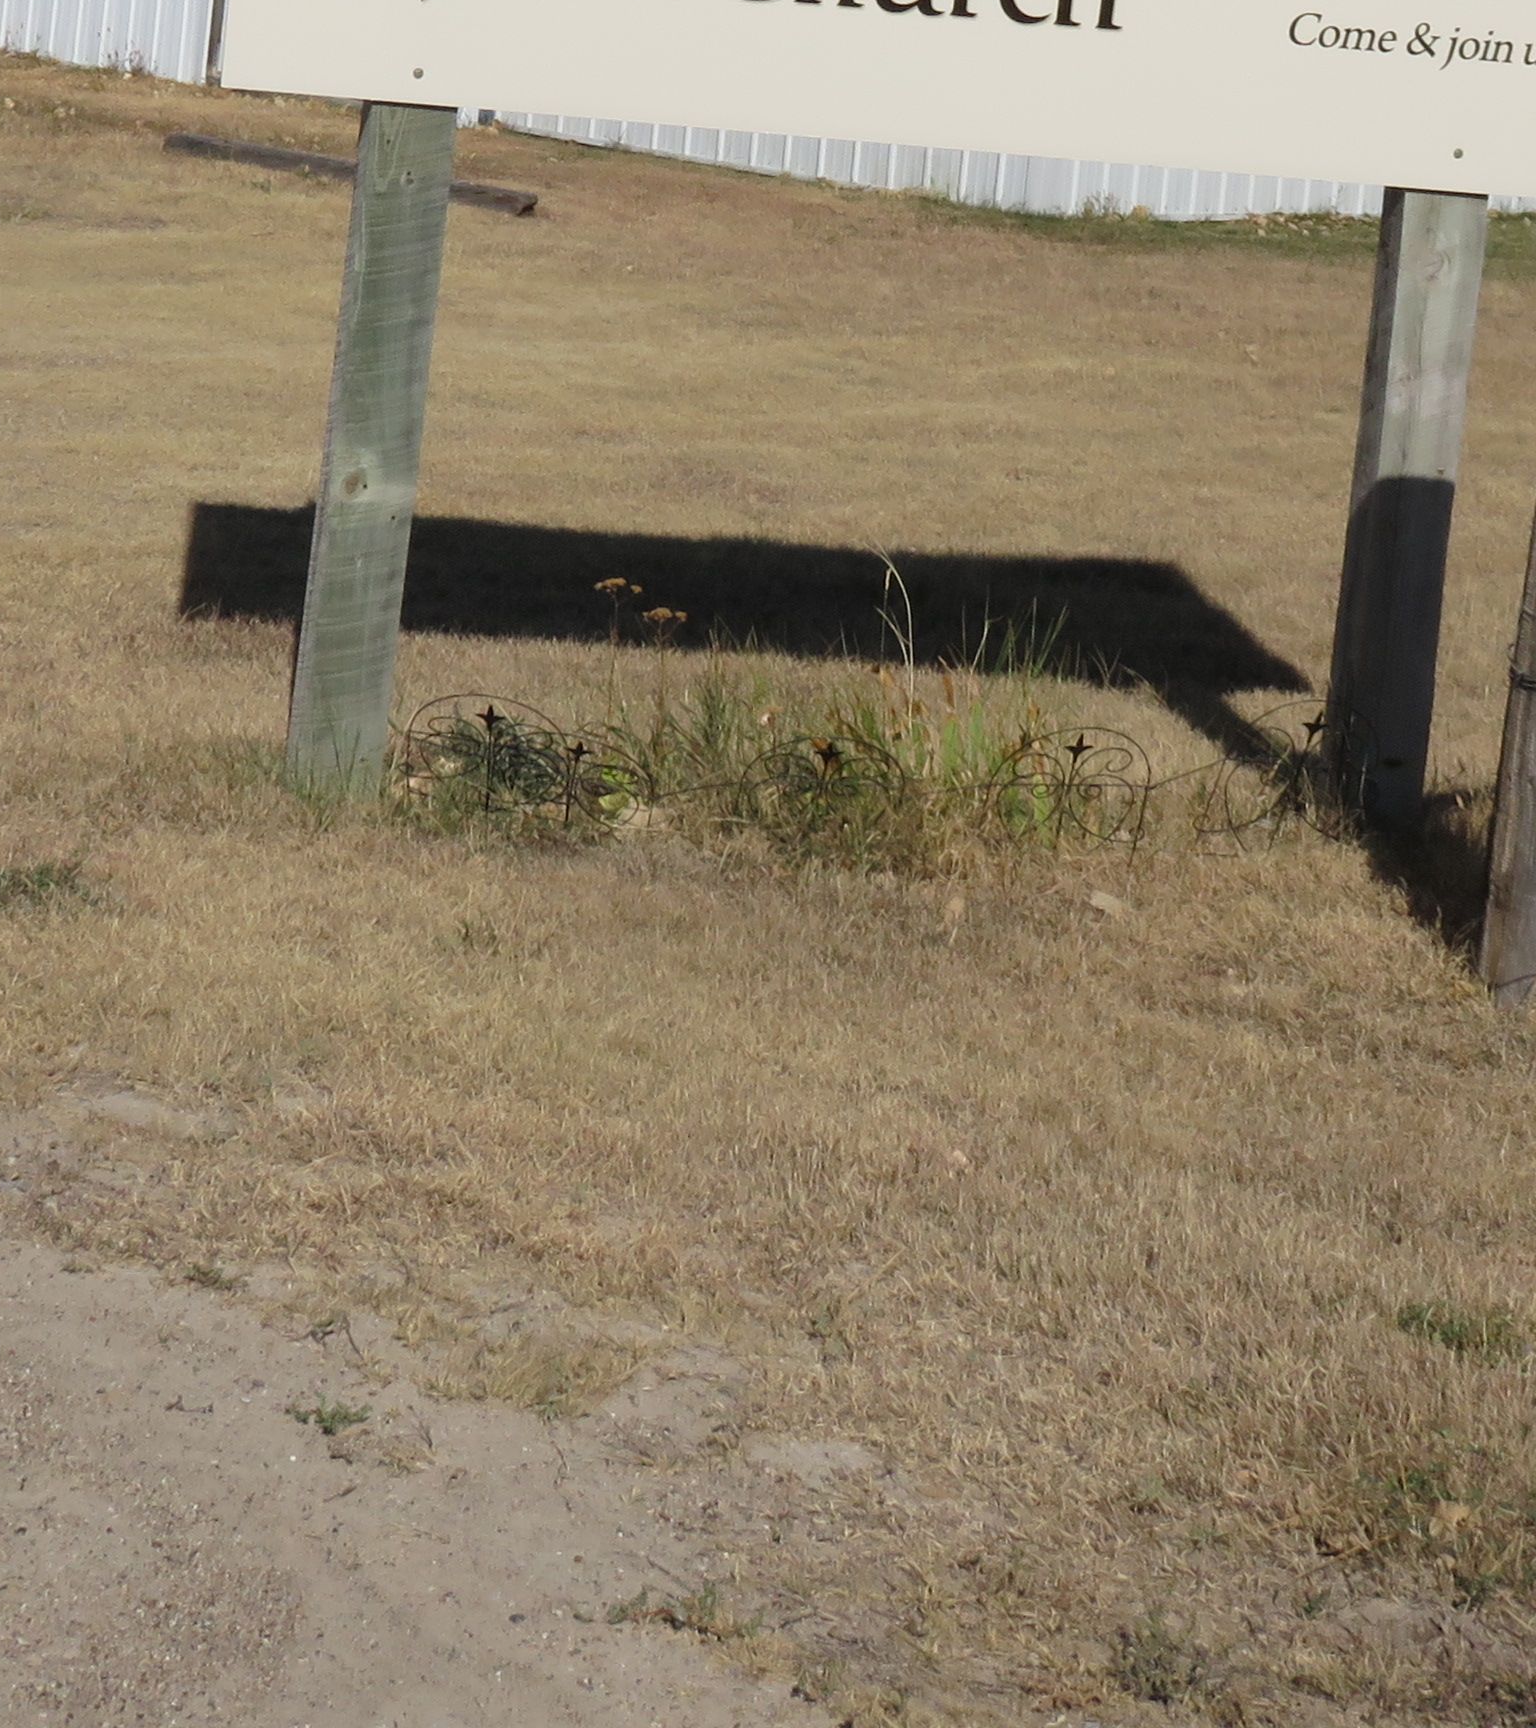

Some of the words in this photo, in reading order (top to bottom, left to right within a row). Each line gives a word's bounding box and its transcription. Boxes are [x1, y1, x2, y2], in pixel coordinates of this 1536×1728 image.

[1288, 12, 1397, 53] Come
[1406, 22, 1440, 57] &
[1440, 27, 1514, 70] join
